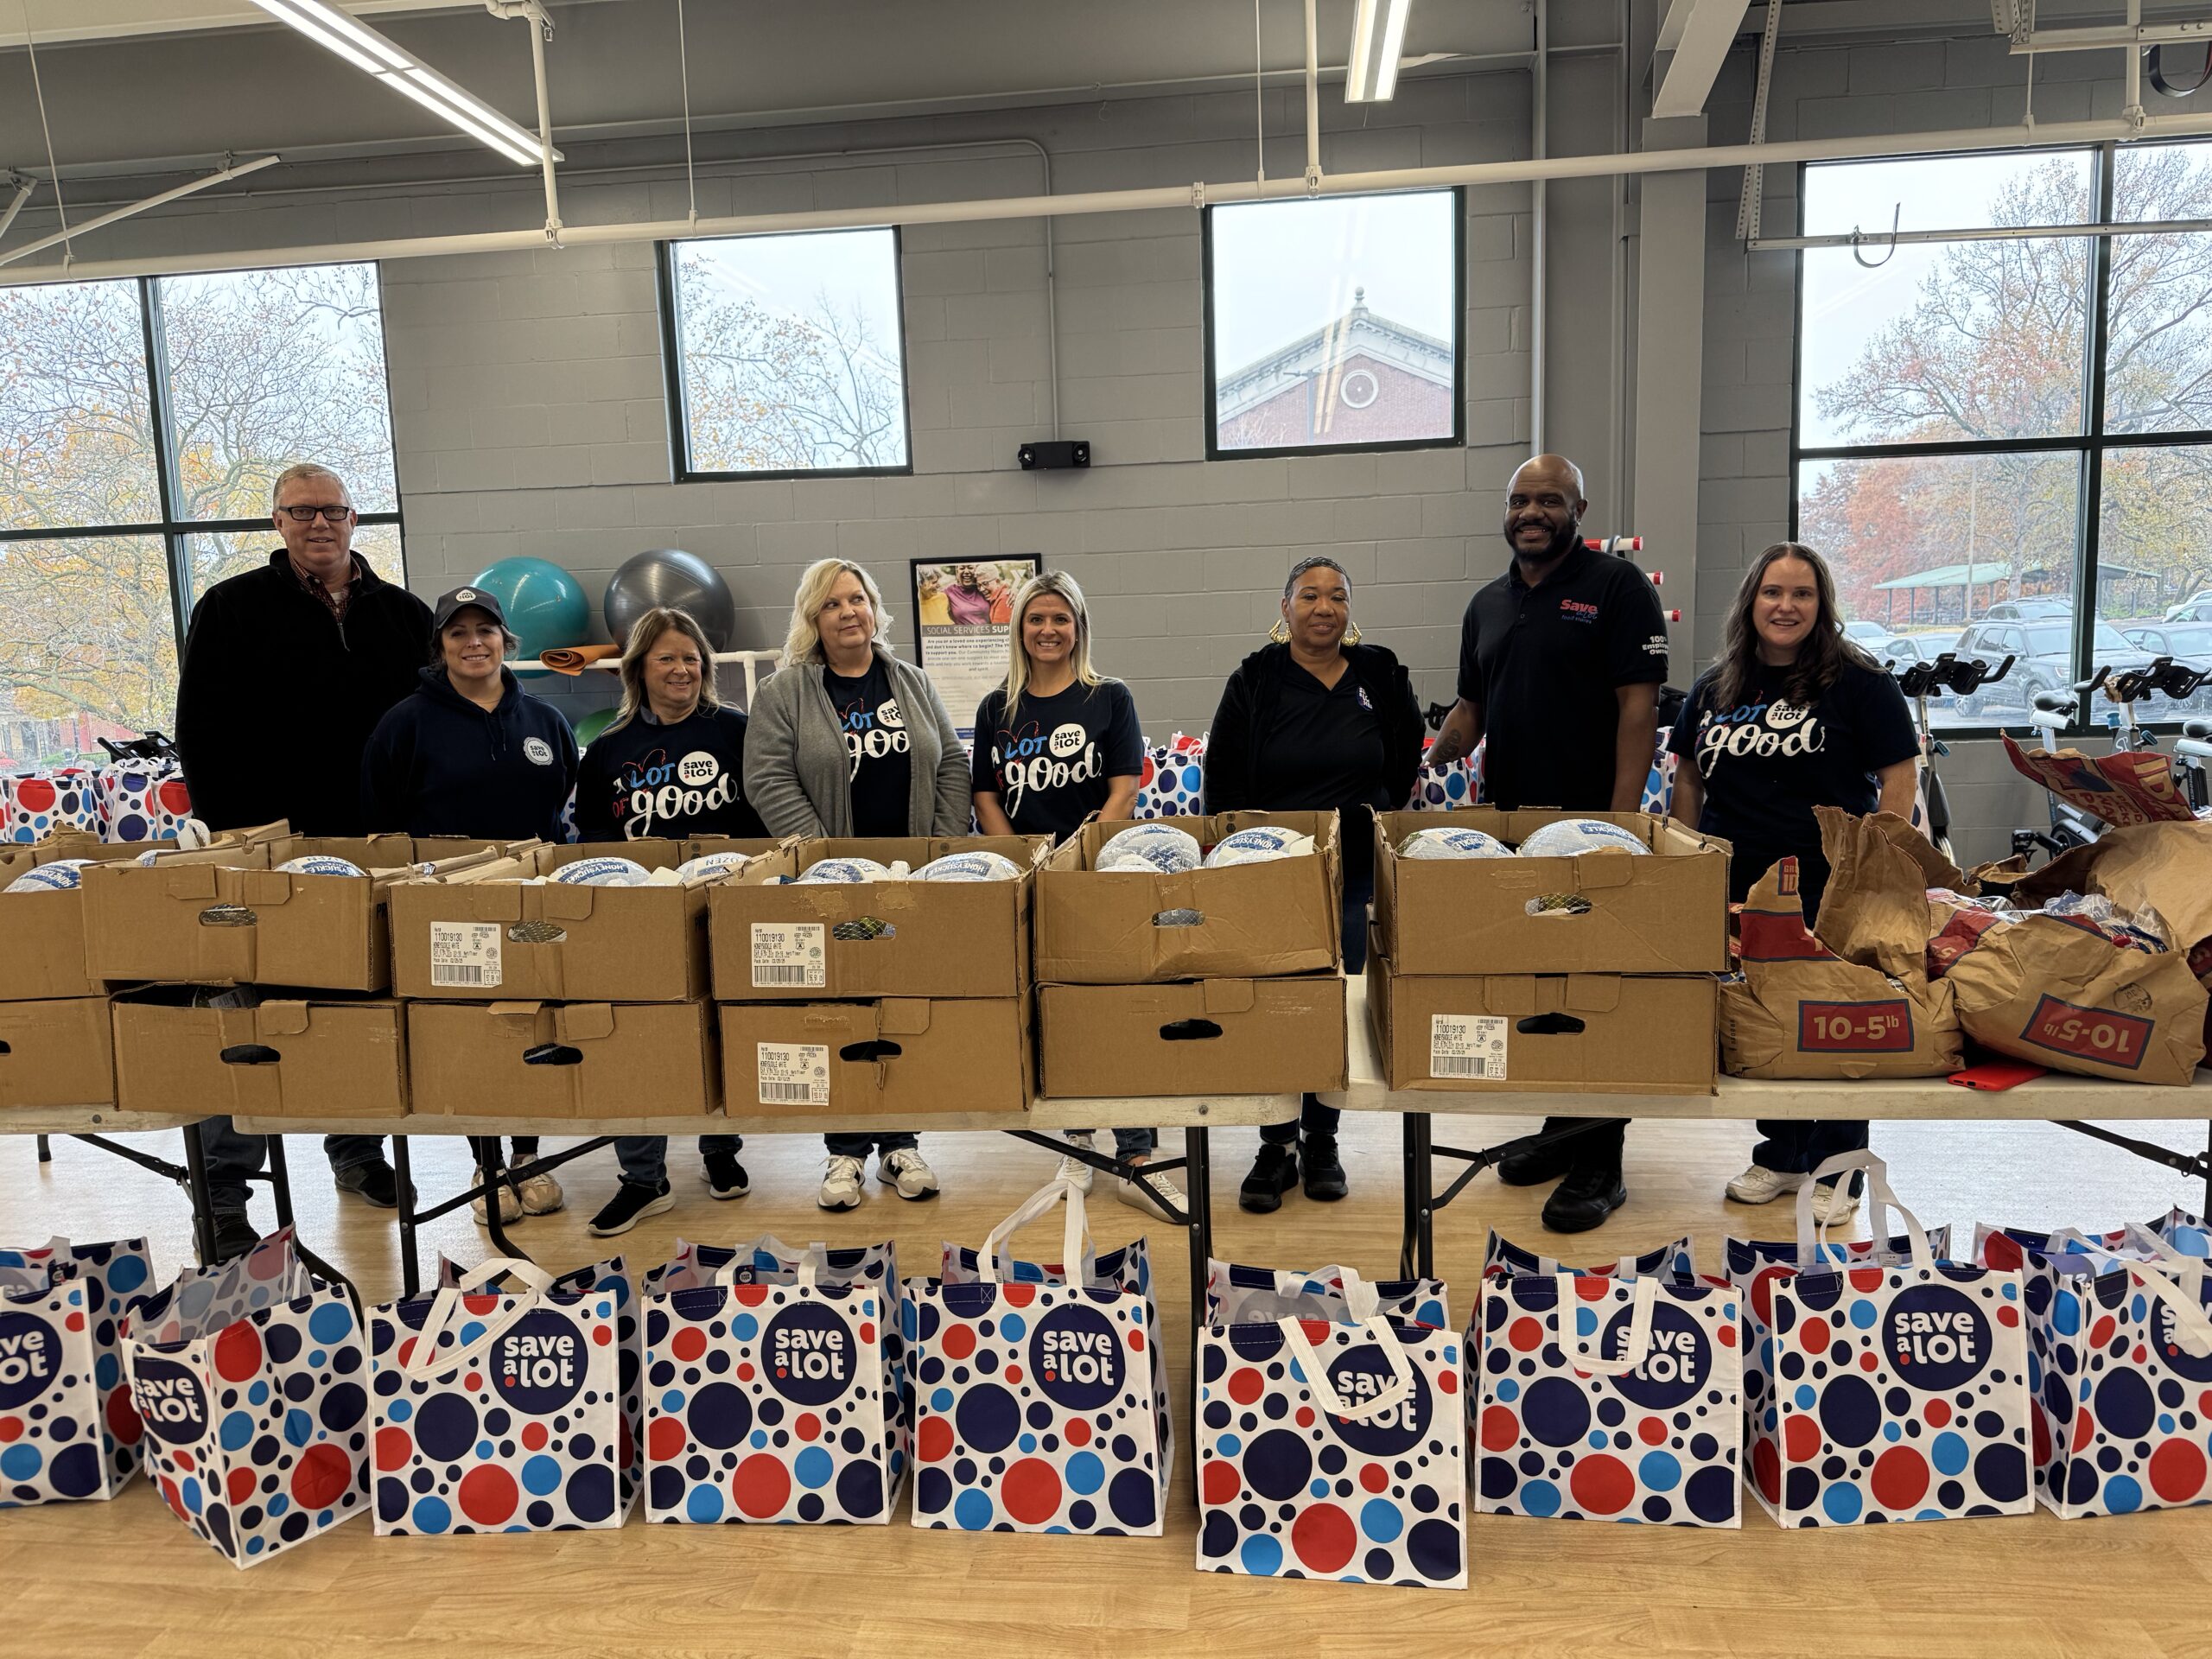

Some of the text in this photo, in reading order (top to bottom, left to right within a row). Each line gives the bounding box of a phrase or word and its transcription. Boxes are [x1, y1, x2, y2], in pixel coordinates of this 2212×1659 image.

[1560, 599, 1598, 613] Save
[927, 626, 951, 635] SOCIAL
[954, 626, 990, 634] SERVICES
[881, 706, 899, 716] sav
[890, 712, 902, 721] lo
[1774, 704, 1805, 713] save
[1778, 711, 1802, 721] lot
[1054, 730, 1081, 741] save
[1059, 737, 1080, 749] lot
[843, 728, 910, 784] goo
[1004, 736, 1047, 760] LOT
[683, 760, 713, 770] save
[690, 768, 714, 778] lot
[630, 763, 676, 789] LOT
[613, 798, 629, 818] OF
[705, 857, 739, 867] OZEN
[1783, 874, 1797, 892] ID
[435, 933, 463, 942] 110019130
[755, 933, 785, 943] 110019130
[1436, 1025, 1466, 1034] 110019130
[761, 1052, 790, 1061] 110019130
[1894, 1312, 1974, 1334] save
[0, 1331, 44, 1359] ve
[504, 1335, 575, 1357] save
[775, 1328, 843, 1351] save
[1042, 1331, 1112, 1356] save
[1616, 1325, 1696, 1353] sve
[1897, 1334, 1976, 1364] a lot
[0, 1351, 48, 1384] ot
[503, 1358, 574, 1388] a lot
[774, 1351, 845, 1381] a lot
[1042, 1353, 1115, 1386] a lot
[135, 1376, 194, 1398] save
[146, 1397, 202, 1423] lot
